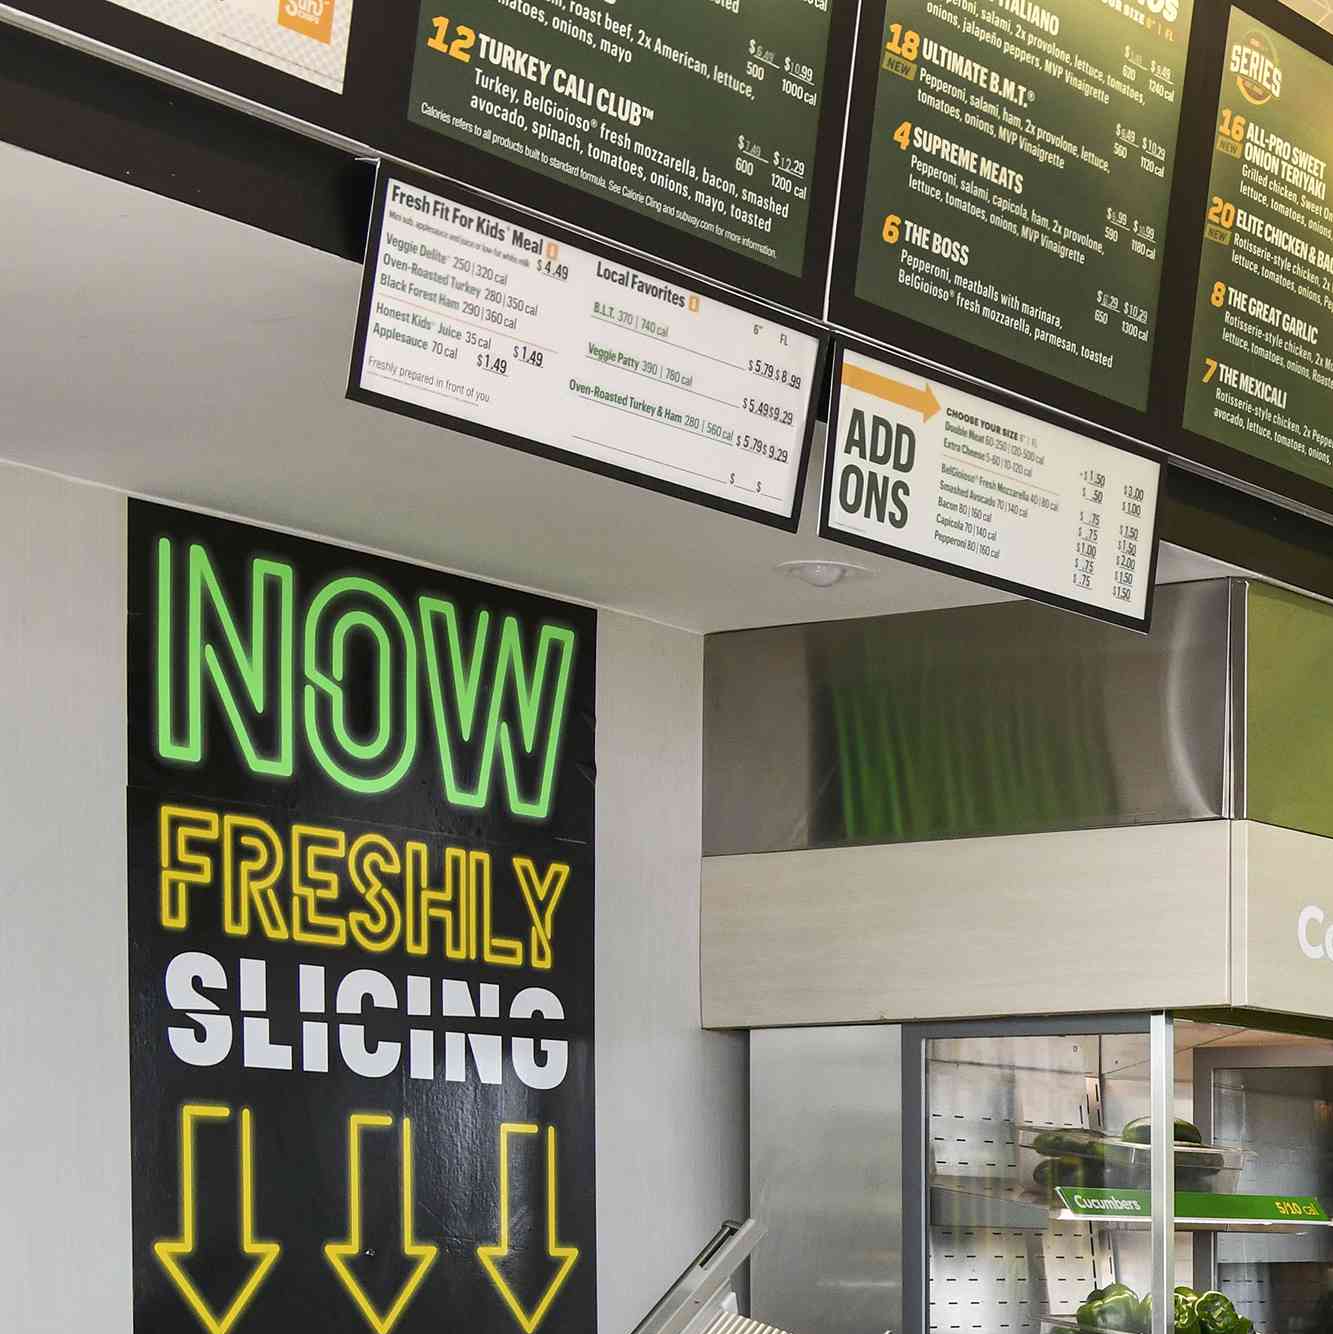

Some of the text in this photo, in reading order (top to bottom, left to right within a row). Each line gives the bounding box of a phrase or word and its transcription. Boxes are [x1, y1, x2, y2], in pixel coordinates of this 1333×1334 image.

[427, 15, 476, 64] 12
[605, 14, 755, 101] beef, American, lettuce,
[886, 24, 920, 61] 18
[922, 38, 987, 88] ULTIMATE
[477, 33, 594, 106] TURKEY CALI
[1230, 45, 1282, 98] SERIES
[920, 67, 1023, 130] Pepperoni, salami, ham,
[470, 95, 648, 187] avocado, spinach, tomatoes,
[474, 68, 789, 219] Turkey, fresh mozzarella, bacon, smashed
[893, 121, 912, 150] 4
[1219, 107, 1246, 144] 16
[914, 126, 1023, 194] SUPREME MEATS
[1244, 144, 1326, 200] ONION TERIYAKI
[1247, 123, 1290, 157] ALL-PRO
[1291, 146, 1326, 179] SWEET
[392, 184, 430, 214] Fresh
[433, 201, 449, 221] Fit
[452, 209, 474, 230] For
[512, 230, 544, 255] Meal
[882, 214, 900, 244] 6
[1208, 196, 1236, 229] 20
[1235, 207, 1262, 243] ELITE
[1264, 221, 1308, 264] CHICKEN
[387, 233, 418, 255] Veggie
[904, 220, 970, 266] THE BOSS
[380, 273, 460, 310] Black Forest Ham
[383, 252, 481, 299] Oven-Roasted Turkey
[597, 261, 685, 308] Local Favorites
[901, 250, 1063, 330] Pepperoni, meatballs with marinara,
[1211, 281, 1226, 308] 8
[373, 323, 428, 351] Applesauce
[376, 302, 462, 340] Honest Juice
[1228, 287, 1318, 345] THE GREAT GARLIC
[589, 342, 639, 371] Veggie Patty
[1034, 326, 1113, 368] parmesan, toasted
[368, 356, 490, 403] Freshly prepared front you
[1201, 358, 1217, 384] 7
[1219, 363, 1288, 409] THE MEXICALI
[844, 408, 916, 473] ADD
[946, 407, 1018, 441] CHOOSE YOUR SIZE
[839, 464, 910, 529] ONS
[156, 536, 577, 820] NOW
[159, 803, 570, 969] FRESHLY
[163, 950, 570, 1092] SLICING
[1074, 1194, 1140, 1213] Cucumbers
[1275, 1201, 1320, 1217] 5/10 cal
